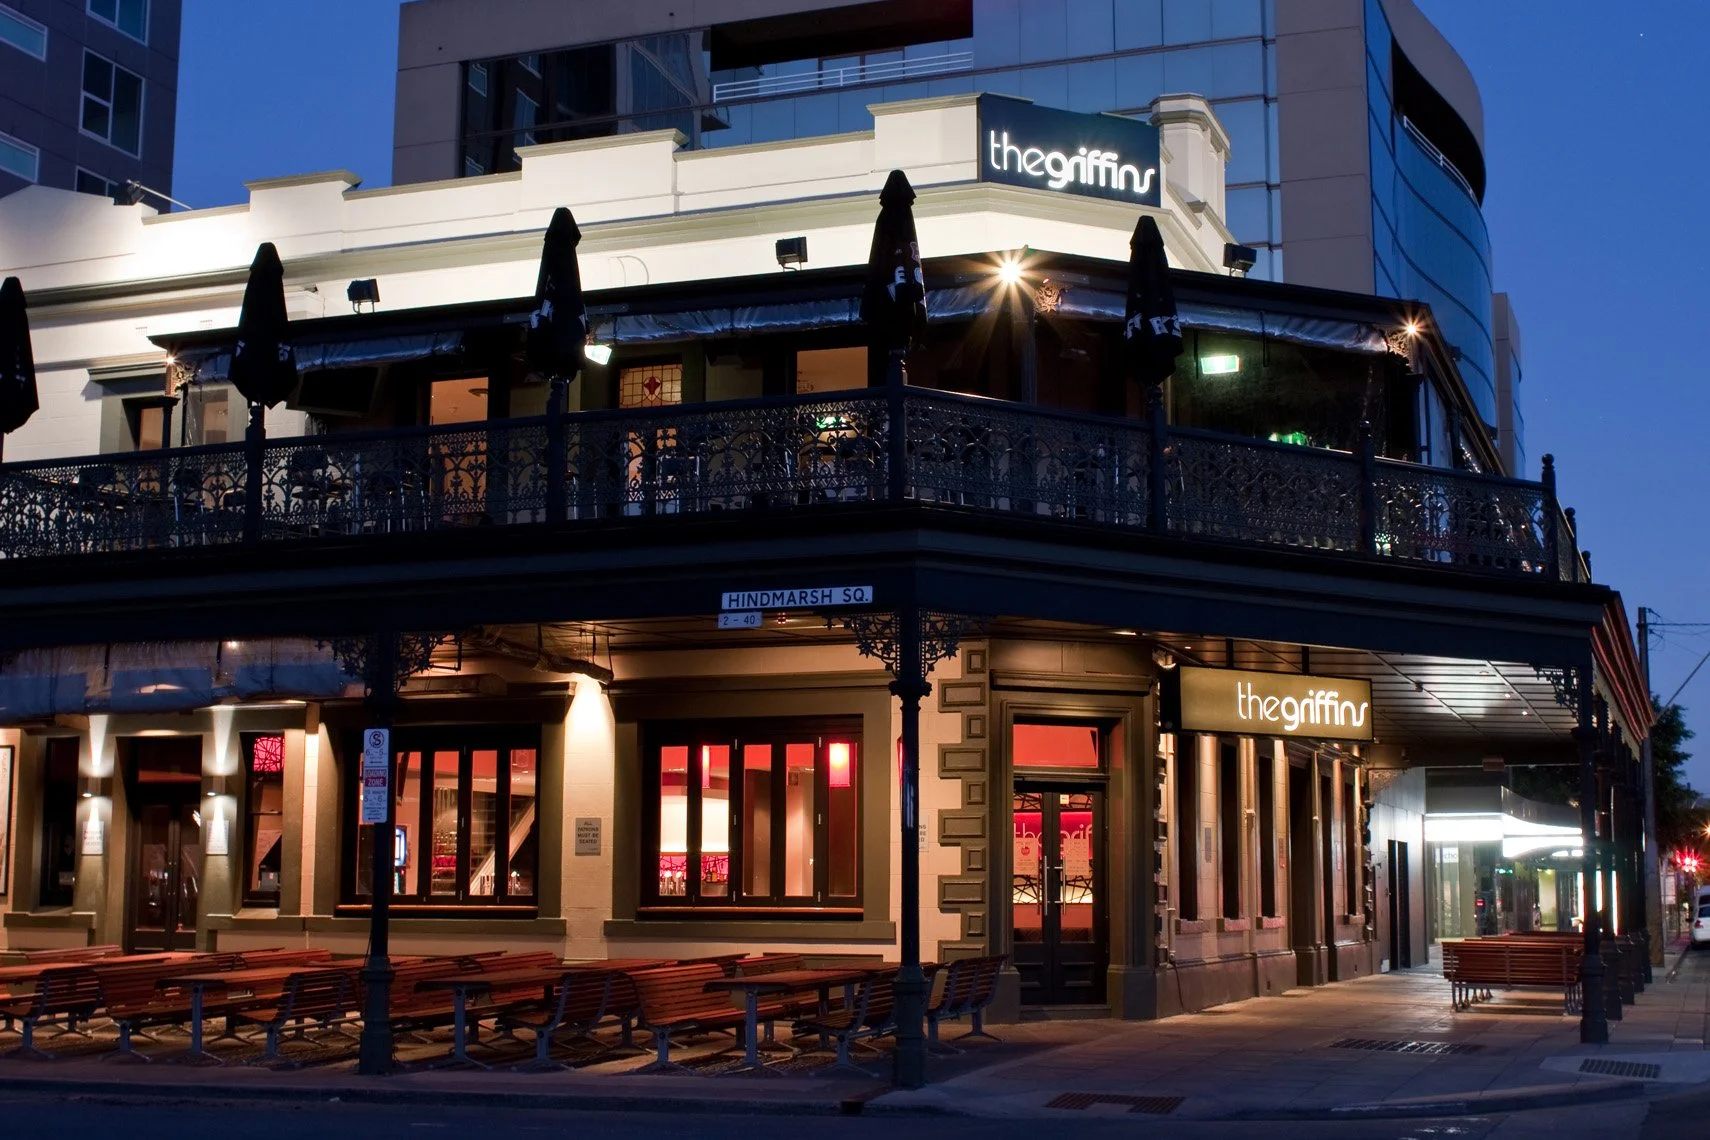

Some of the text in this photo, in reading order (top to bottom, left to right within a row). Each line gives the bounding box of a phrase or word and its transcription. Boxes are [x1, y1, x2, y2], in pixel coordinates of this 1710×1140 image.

[728, 587, 869, 608] HINDMARSH SQ.
[723, 617, 729, 626] 2
[743, 615, 756, 625] 40
[367, 777, 384, 786] ZONE
